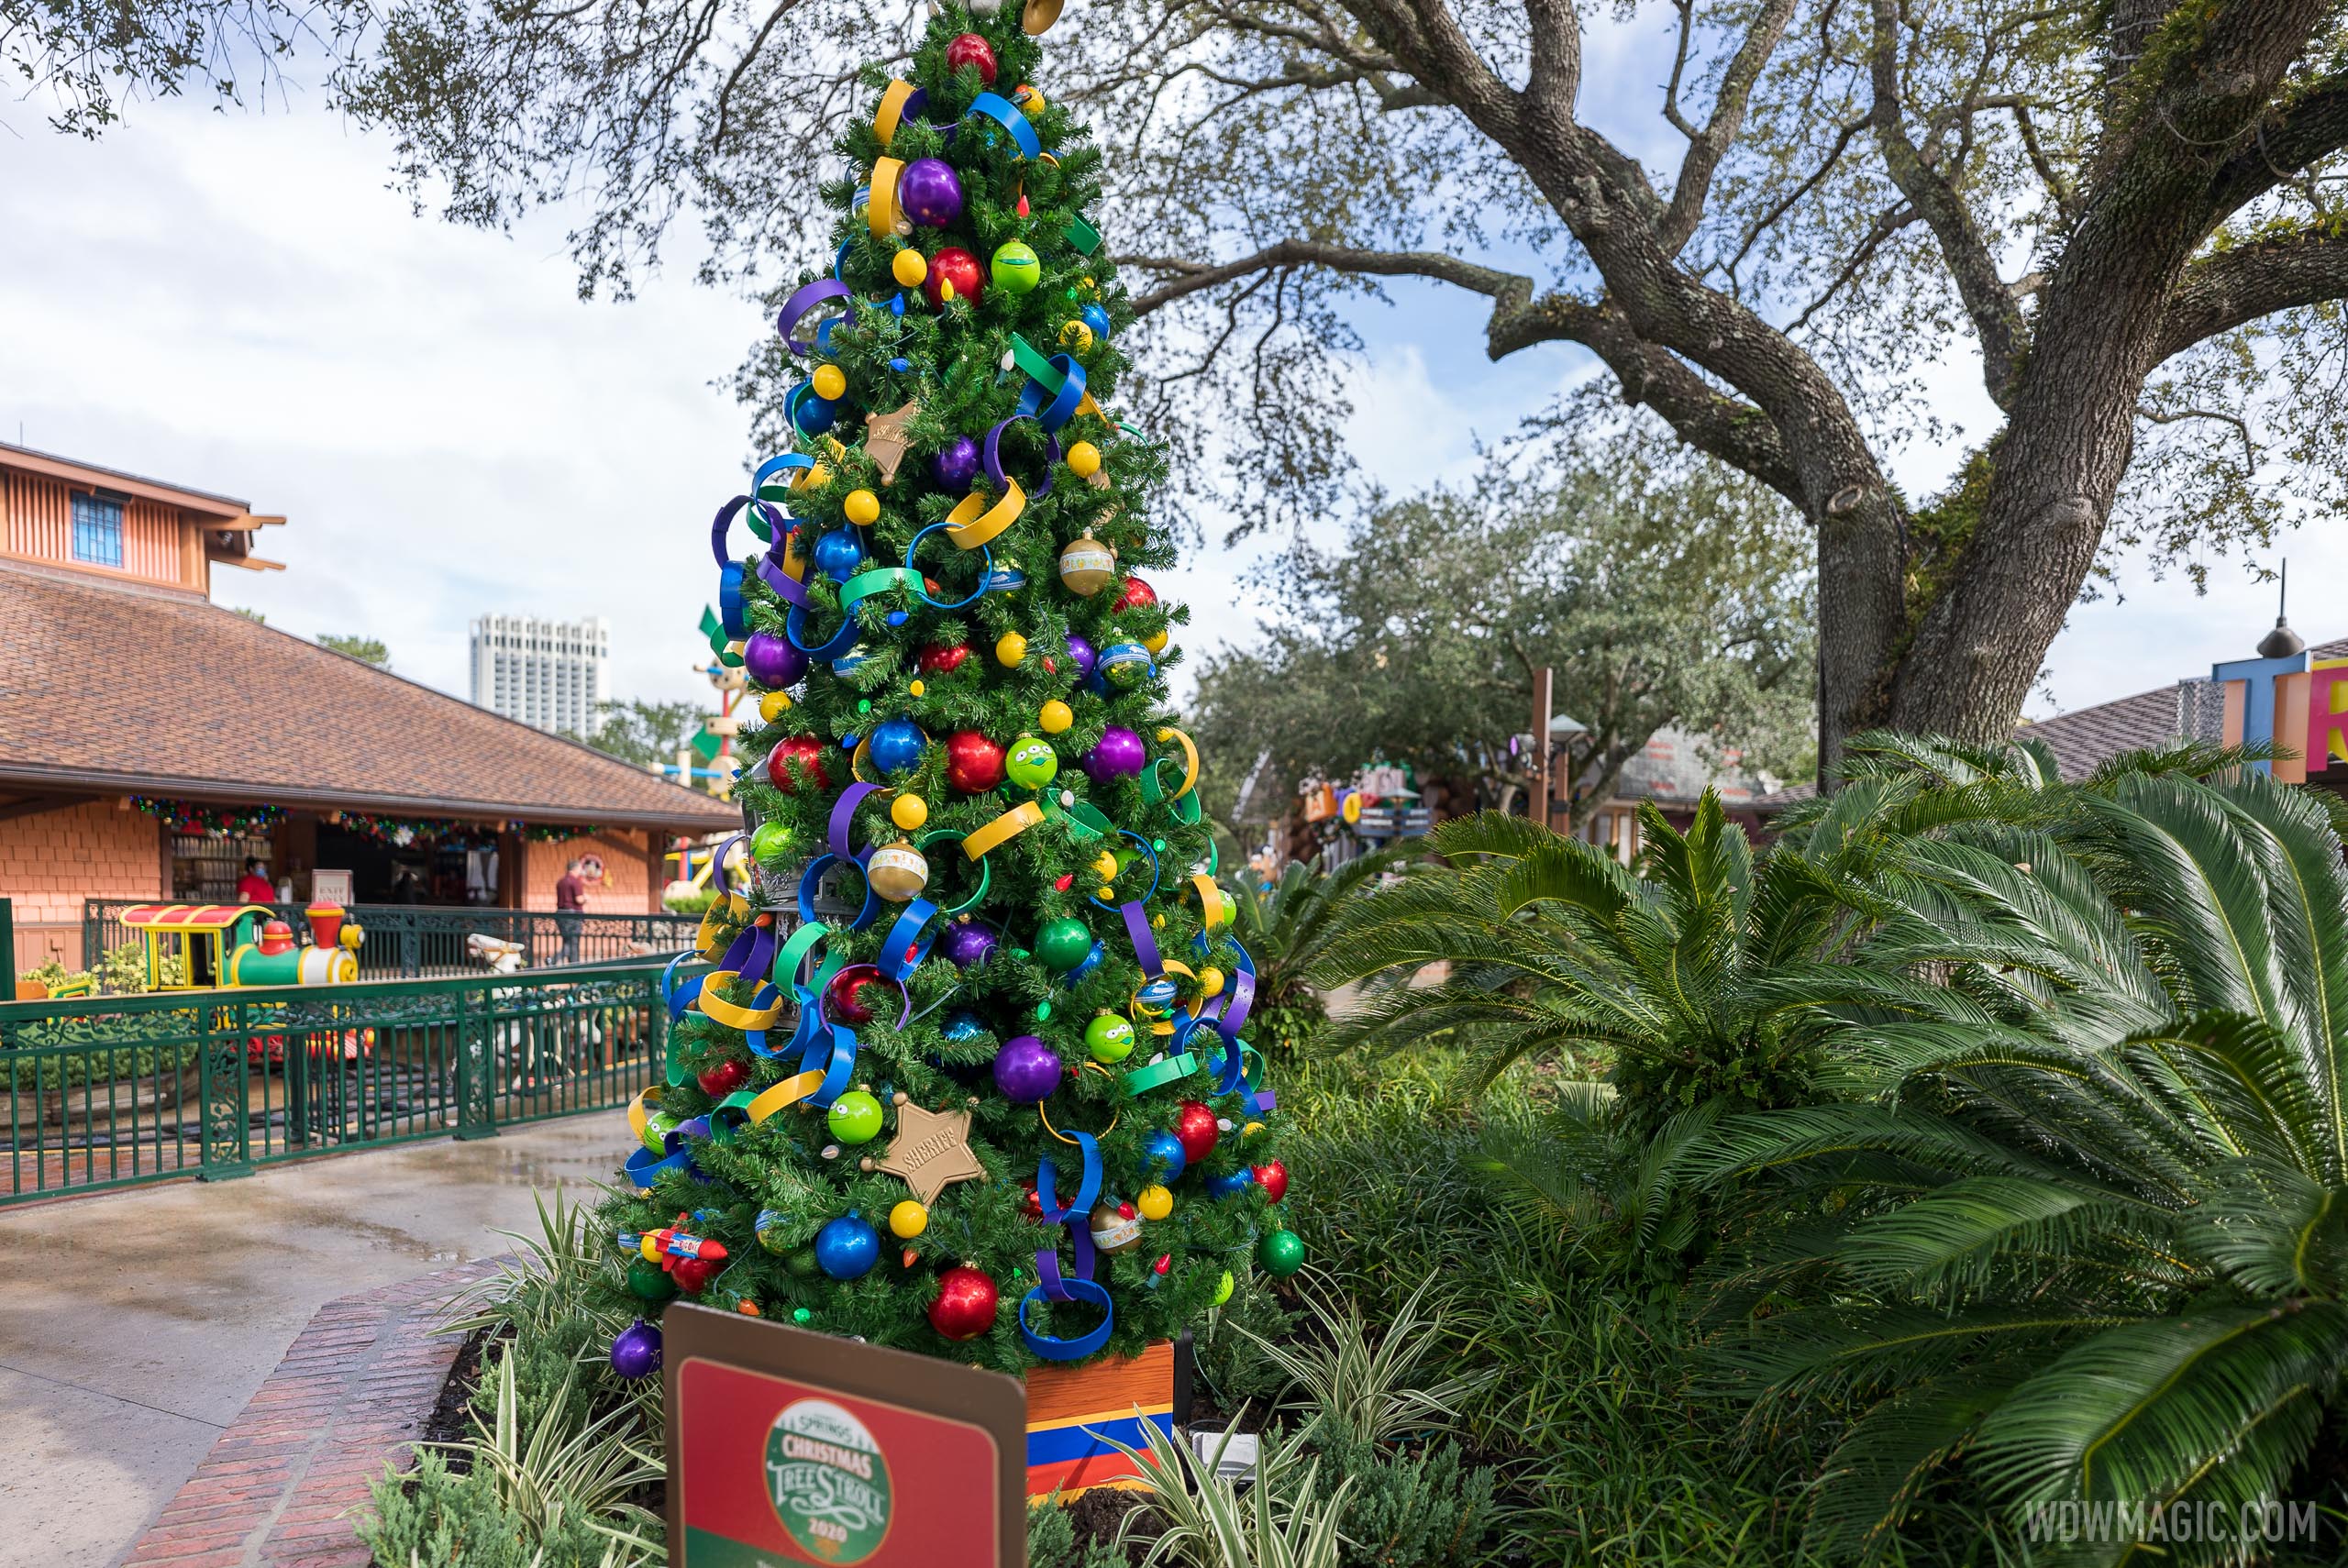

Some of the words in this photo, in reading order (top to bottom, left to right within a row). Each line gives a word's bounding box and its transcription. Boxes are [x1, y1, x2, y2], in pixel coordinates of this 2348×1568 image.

[903, 1126, 958, 1174] SHERIFF
[798, 1414, 854, 1444] SPRINGS
[781, 1433, 873, 1481] CHRISTMAS
[767, 1459, 818, 1507] TREE
[810, 1464, 886, 1527] STROLL
[808, 1516, 848, 1543] 2020
